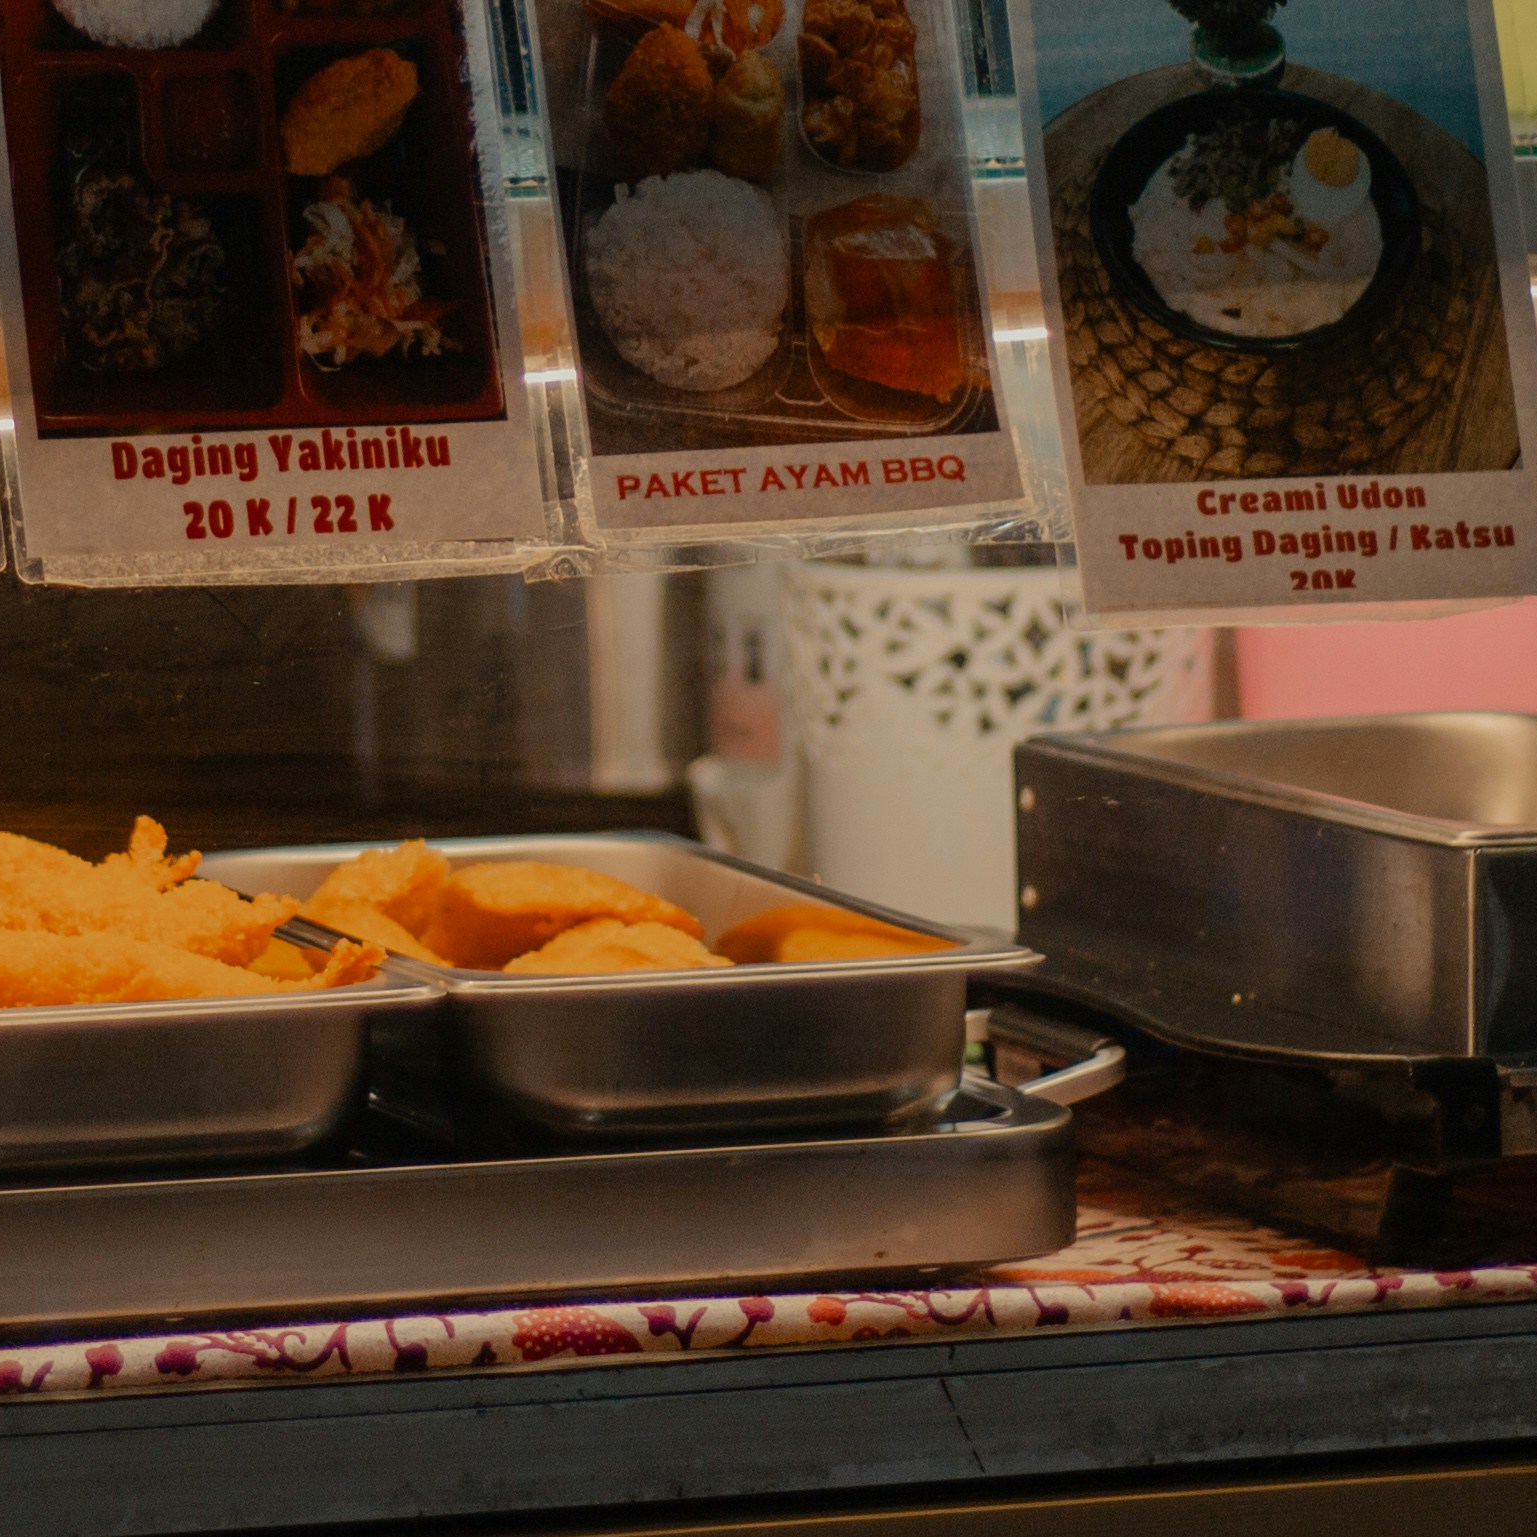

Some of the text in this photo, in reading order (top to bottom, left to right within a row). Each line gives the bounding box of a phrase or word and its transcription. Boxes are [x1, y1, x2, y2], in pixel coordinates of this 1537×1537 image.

[110, 426, 452, 486] Daging Yakiniku
[617, 455, 966, 501] PAKET AYAM BBQ
[183, 494, 394, 540] 20 K / 22 K
[1196, 481, 1427, 516] Creami Udon
[1118, 520, 1515, 565] Toping Daging / Katsu
[1290, 569, 1356, 591] 20K
